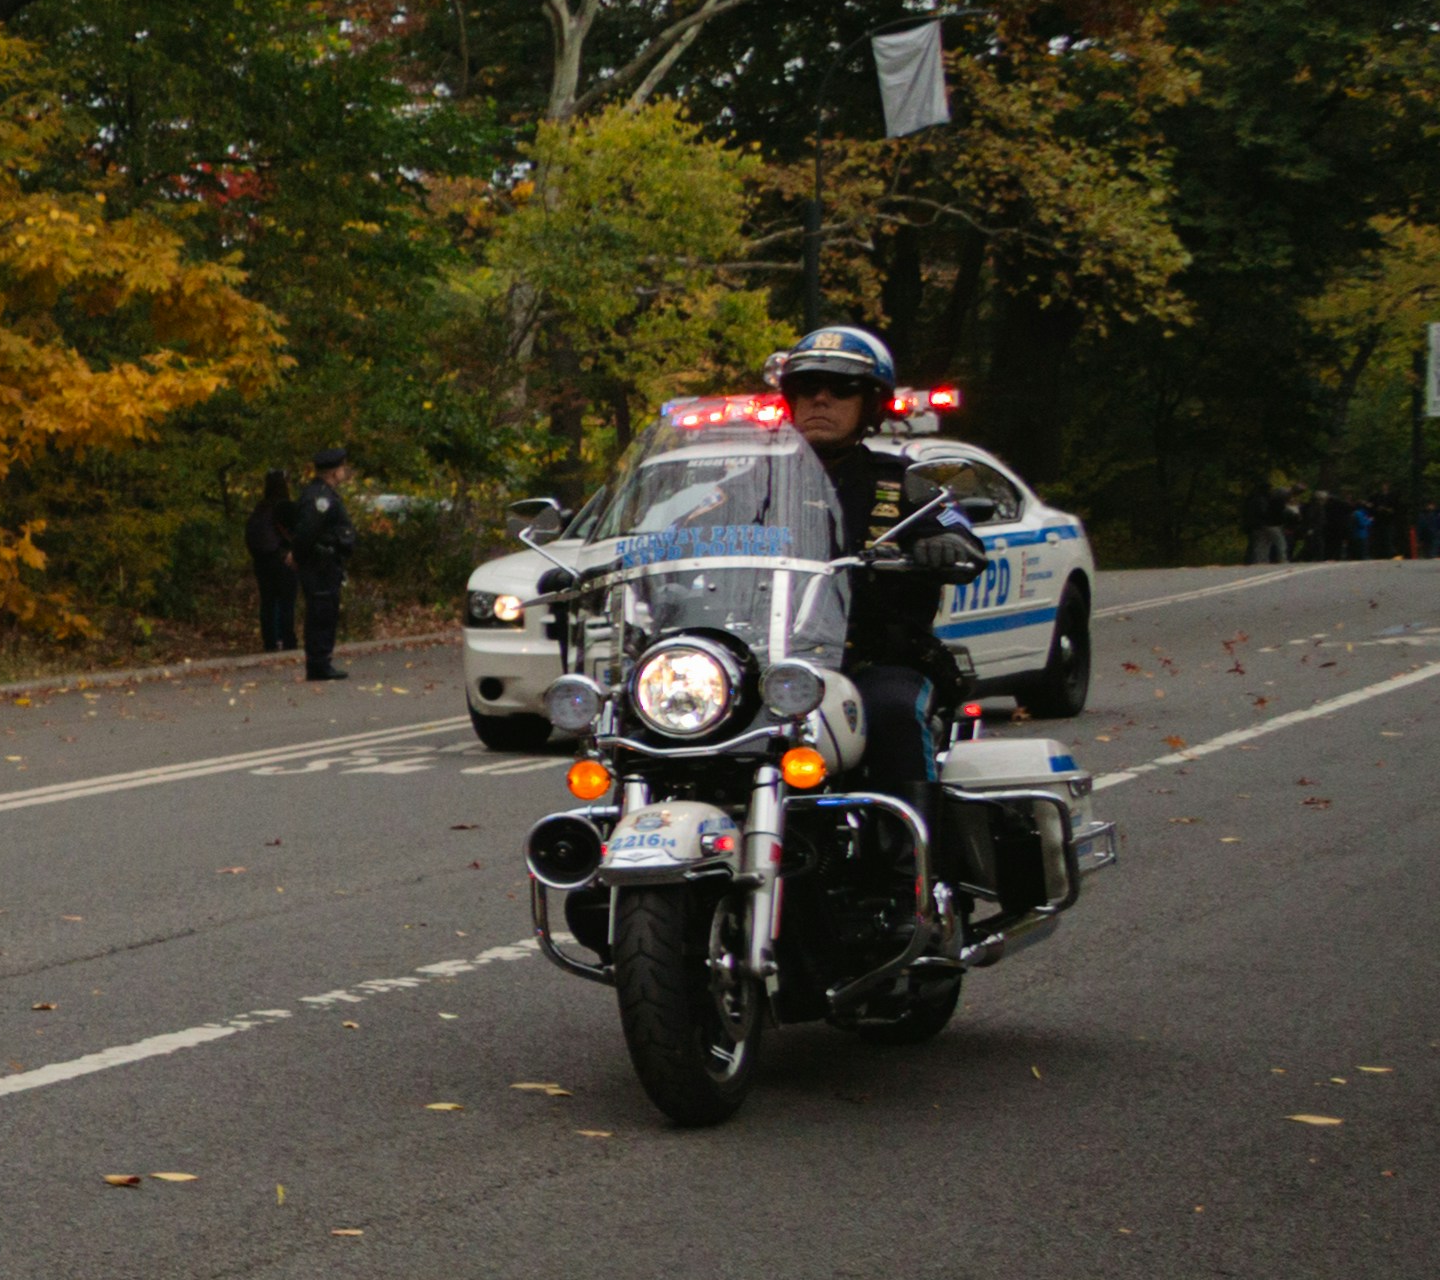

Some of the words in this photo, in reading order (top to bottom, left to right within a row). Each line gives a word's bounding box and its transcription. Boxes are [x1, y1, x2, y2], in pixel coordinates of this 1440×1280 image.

[687, 457, 757, 468] HIGHWAY
[615, 524, 704, 556] HIGHWAY
[711, 524, 793, 544] PATROL
[622, 544, 682, 569] NYPD
[693, 541, 783, 558] POLICE
